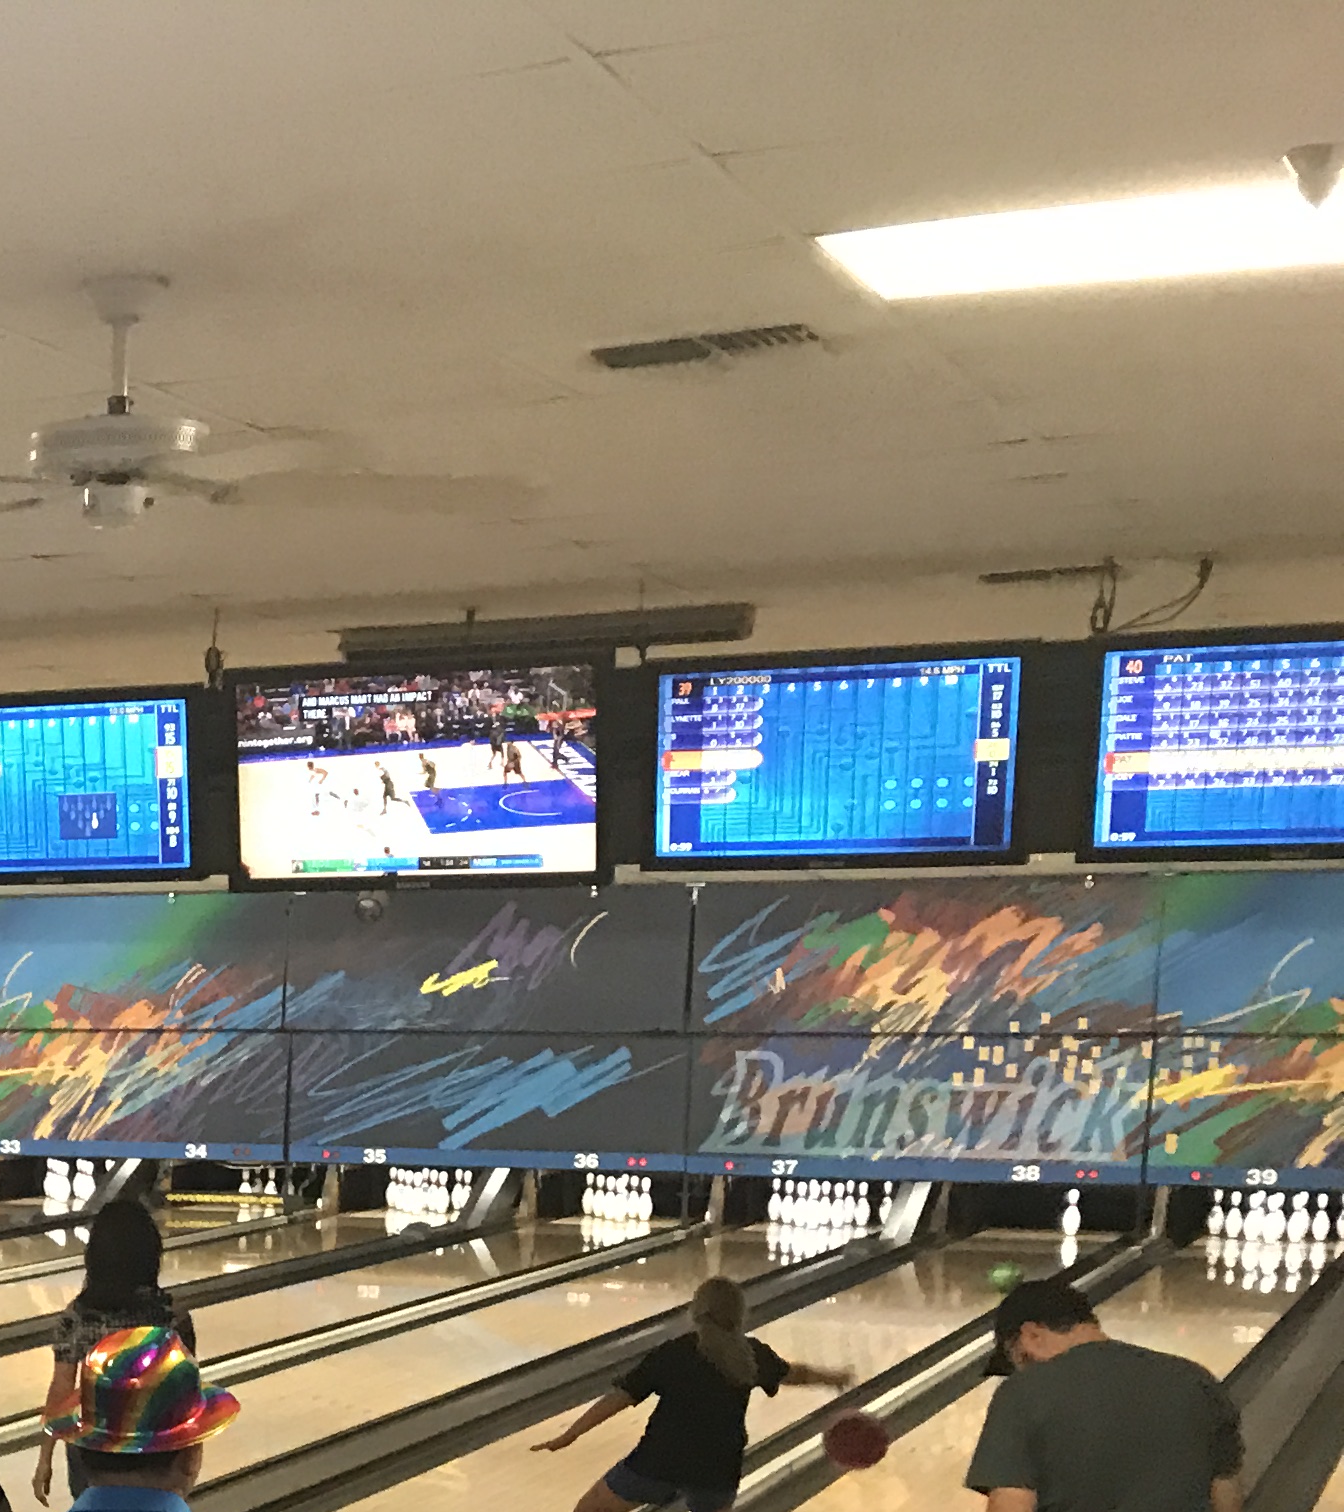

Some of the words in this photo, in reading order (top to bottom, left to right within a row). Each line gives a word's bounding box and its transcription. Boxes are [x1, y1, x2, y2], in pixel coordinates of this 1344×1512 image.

[1163, 654, 1193, 663] PAT
[1193, 663, 1202, 673] 2
[1223, 662, 1232, 672] 3
[1252, 661, 1261, 670] 4
[1281, 659, 1290, 669] 5
[1310, 658, 1320, 668] 6
[988, 663, 1011, 673] TTL
[1125, 660, 1143, 674] 40
[678, 682, 692, 695] 39
[712, 687, 717, 695] 1
[737, 686, 744, 694] 2
[762, 685, 770, 693] 3
[787, 683, 795, 692] 4
[813, 682, 821, 691] 5
[839, 680, 848, 690] 6
[867, 679, 874, 688] 7
[1118, 677, 1145, 685] STEVE
[319, 695, 349, 706] MARCUS
[401, 691, 433, 701] IMPACT
[160, 705, 179, 713] TTL
[1110, 832, 1136, 841] 0:59
[714, 1050, 1132, 1154] Brunswick
[0, 1139, 21, 1154] 33
[185, 1143, 207, 1159] 34
[363, 1148, 386, 1164] 35
[574, 1153, 599, 1169] 36
[772, 1160, 798, 1176] 37
[1012, 1165, 1040, 1182] 38
[1246, 1168, 1278, 1186] 39
